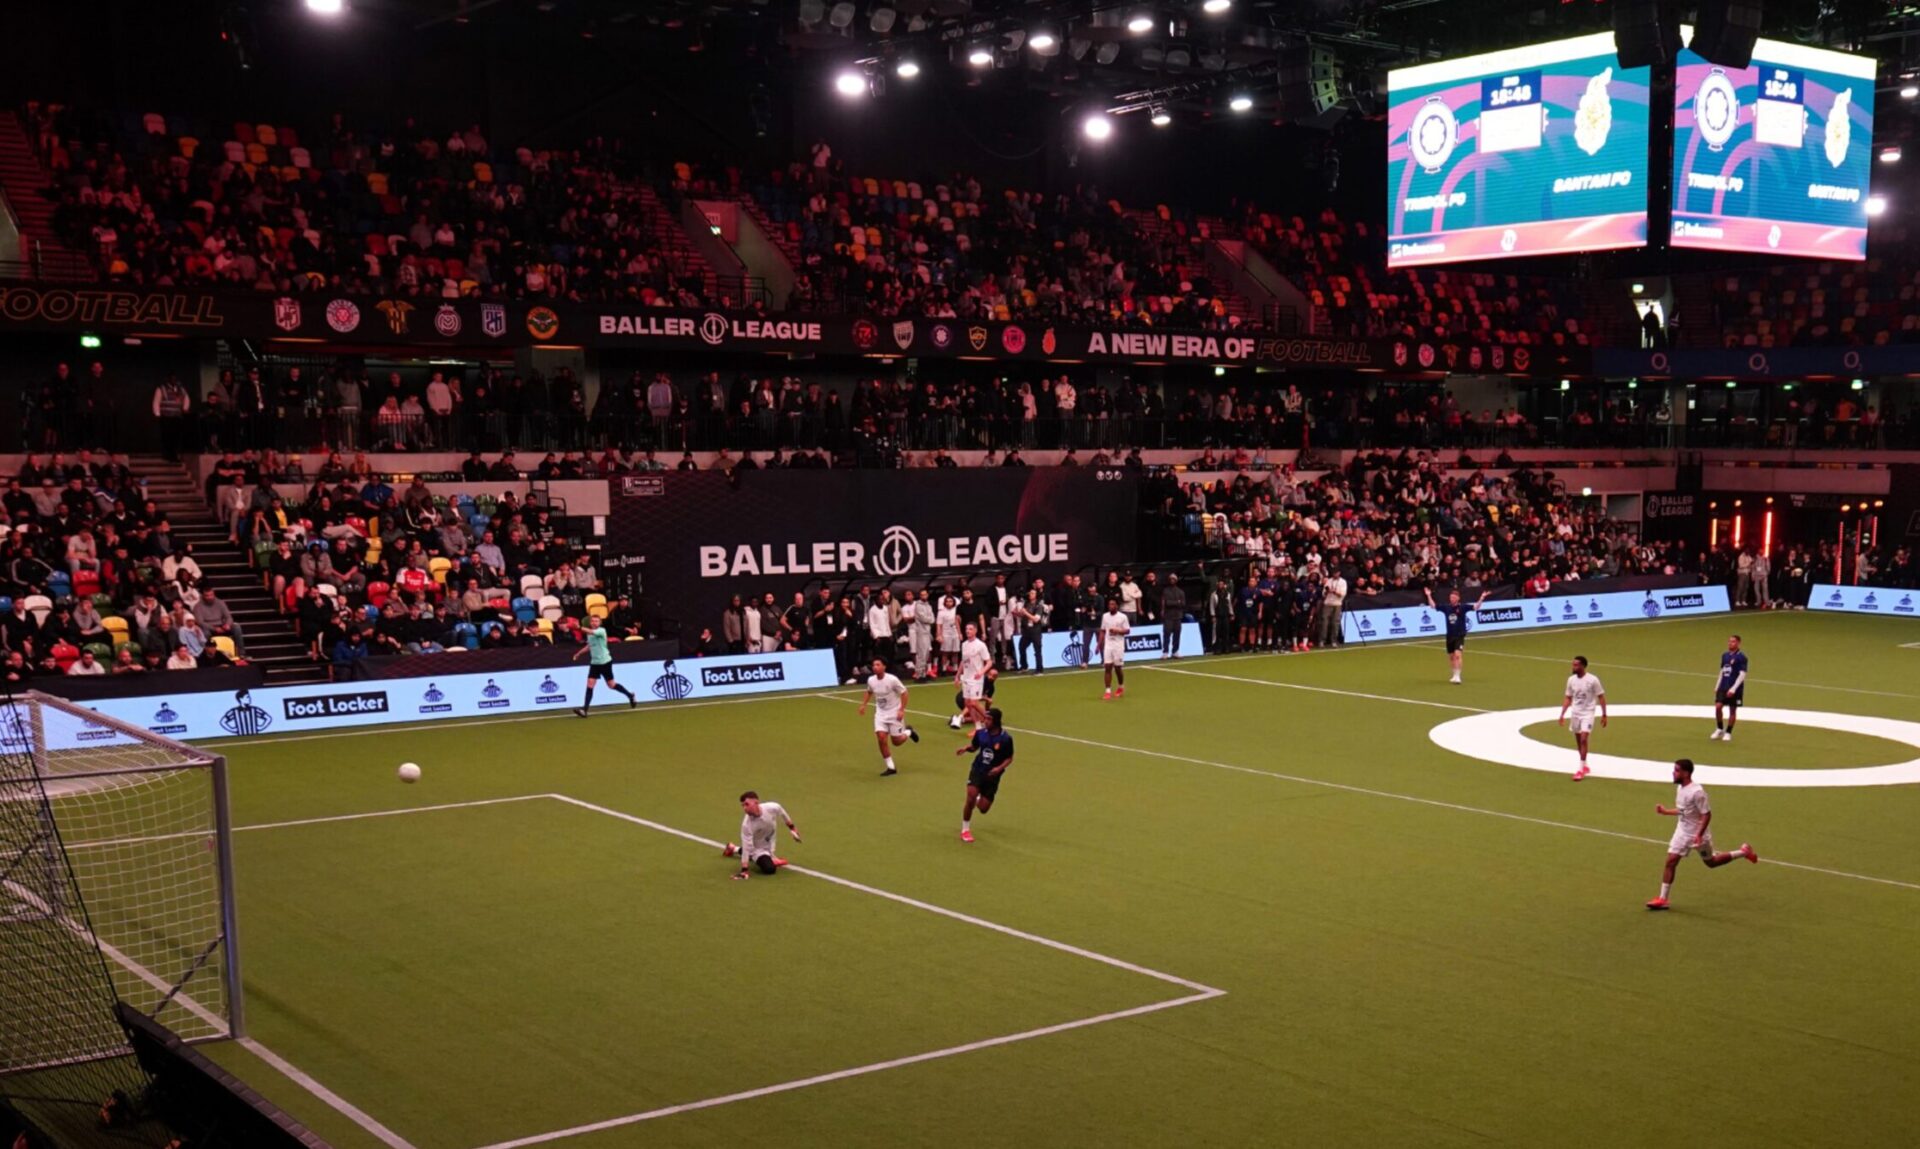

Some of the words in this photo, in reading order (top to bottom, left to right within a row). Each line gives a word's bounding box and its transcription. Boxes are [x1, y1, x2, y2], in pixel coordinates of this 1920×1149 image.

[0, 287, 224, 326] OOTBALL
[600, 316, 695, 335] BALLER
[732, 321, 821, 340] LEAGUE
[1088, 331, 1108, 354] A
[1111, 332, 1168, 356] NEW
[1171, 335, 1221, 358] ERA
[1224, 336, 1255, 360] OF
[1257, 339, 1371, 363] FOOTBALL
[700, 542, 865, 577] BALLER
[927, 533, 1069, 568] LEAGUE
[1478, 612, 1494, 621] Foot
[1497, 608, 1521, 619] Locker
[1126, 637, 1160, 650] Locker
[704, 669, 735, 684] Foot
[737, 666, 781, 681] Locker
[287, 700, 326, 717] Foot
[328, 696, 384, 713] Locker
